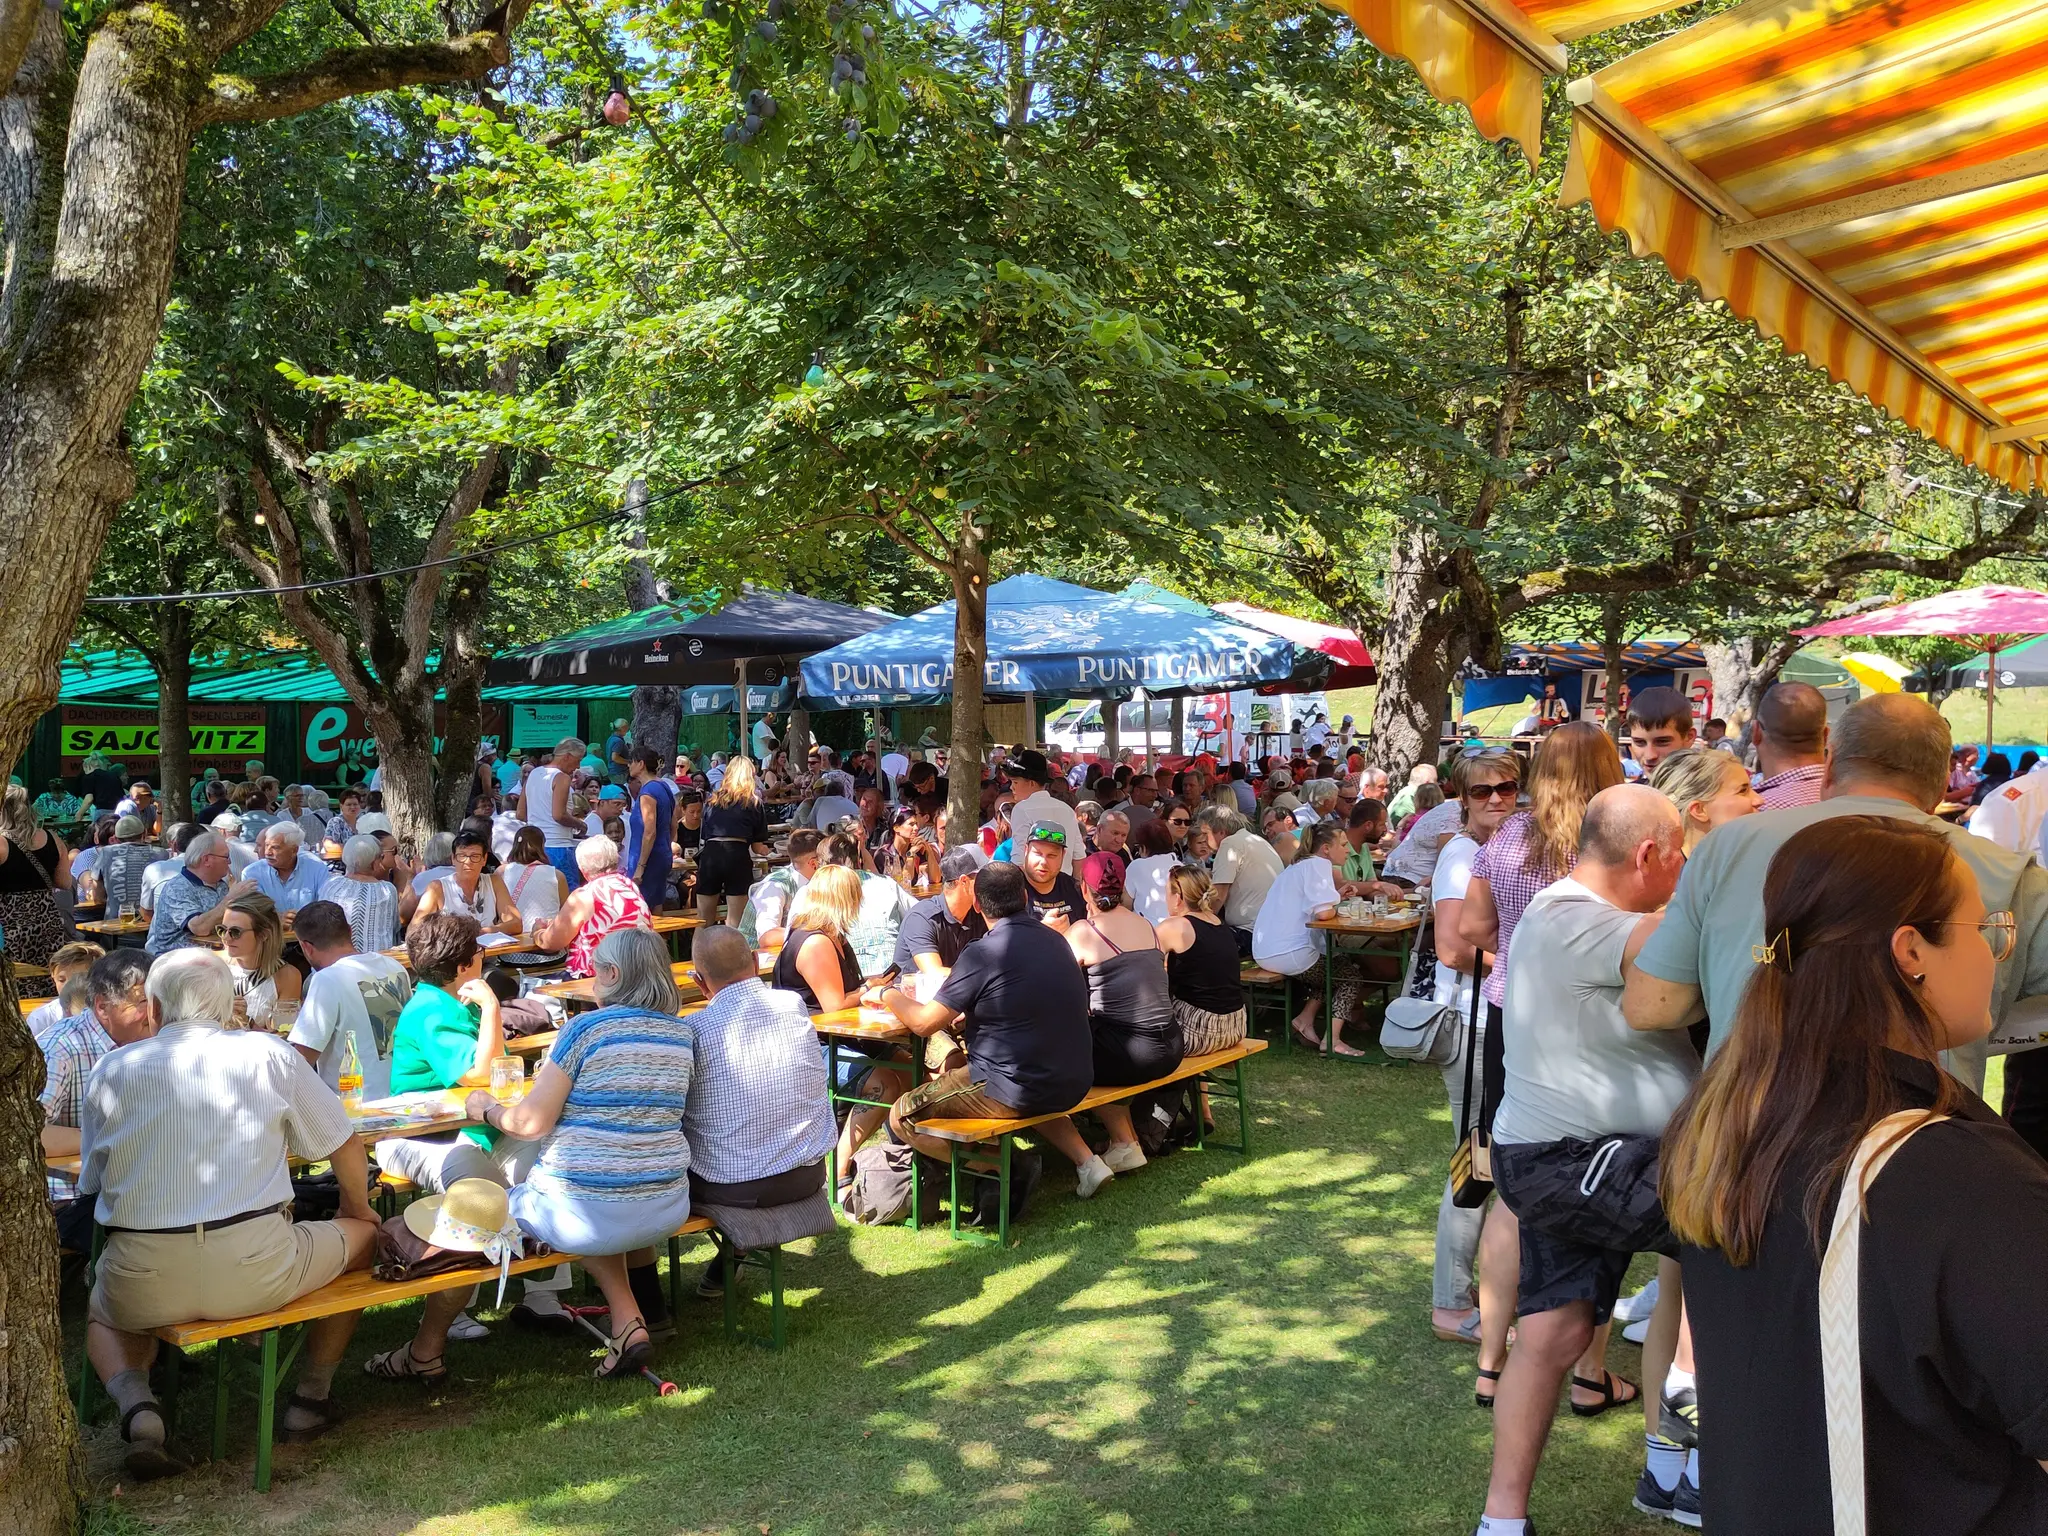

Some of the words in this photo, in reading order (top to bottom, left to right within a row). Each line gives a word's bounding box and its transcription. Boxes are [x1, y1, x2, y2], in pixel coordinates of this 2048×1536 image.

[644, 654, 670, 663] Heineken
[1077, 650, 1262, 683] PUNTIGAMER
[831, 660, 1021, 691] PUNTIGAER
[191, 711, 261, 721] SPENGLEREI
[2008, 1036, 2036, 1045] Bank
